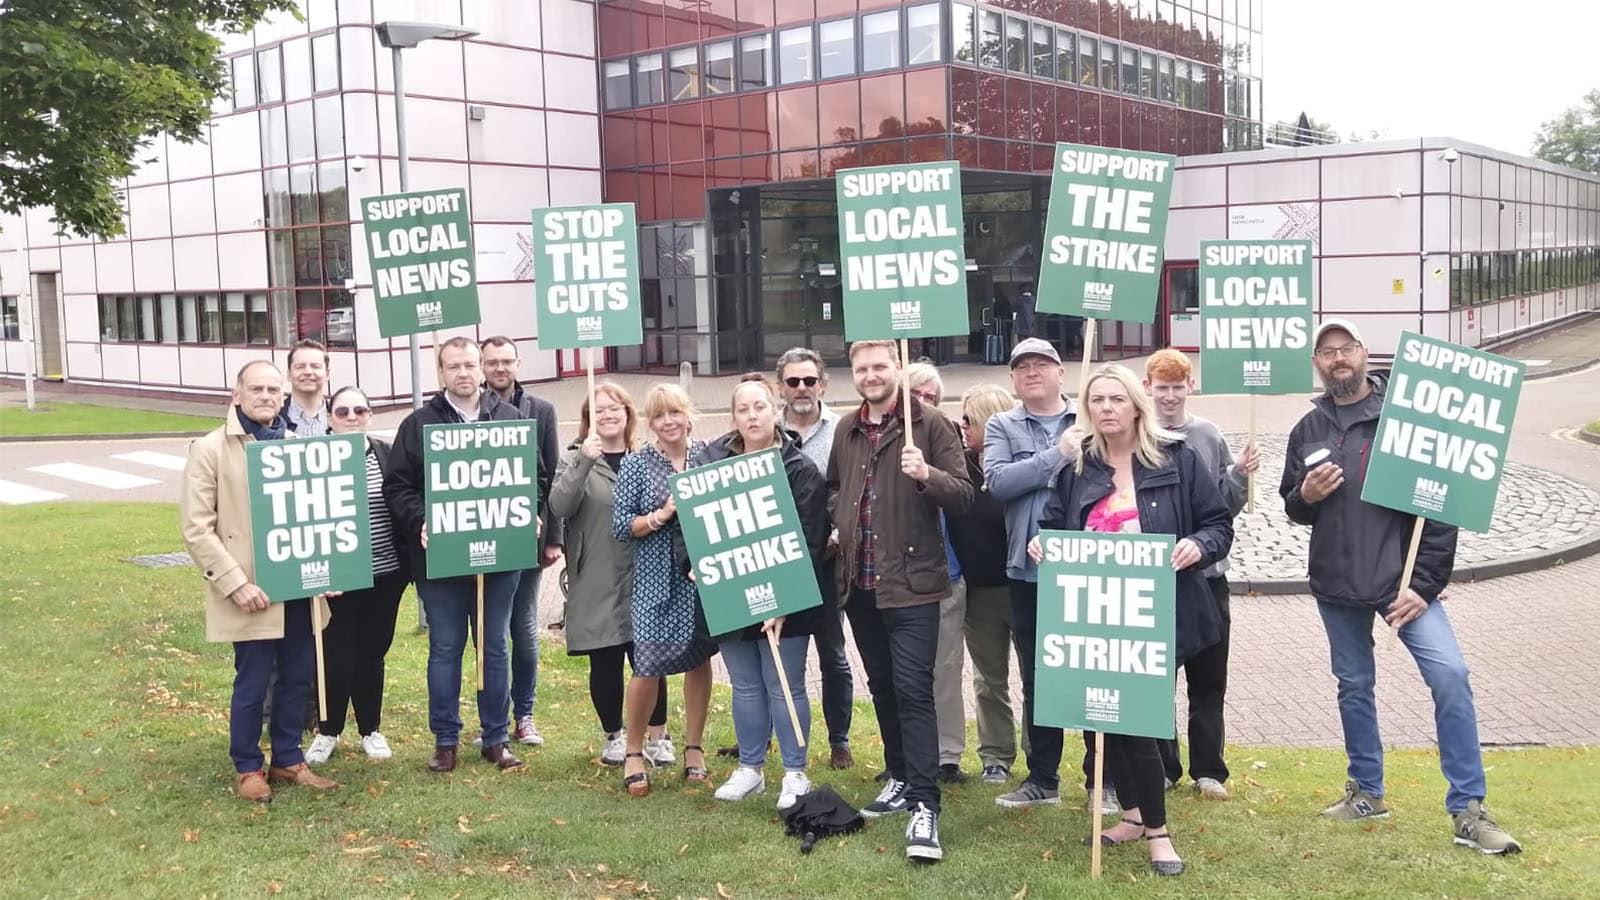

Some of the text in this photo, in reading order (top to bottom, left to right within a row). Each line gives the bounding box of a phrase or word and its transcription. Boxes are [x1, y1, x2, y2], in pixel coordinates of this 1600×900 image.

[842, 167, 954, 198] SUPPORT
[1060, 149, 1170, 183] SUPPORT
[367, 192, 461, 221] SUPPORT
[844, 203, 958, 244] LOCAL
[1067, 183, 1155, 234] THE
[370, 222, 467, 259] LOCAL
[543, 208, 625, 241] STOP
[544, 239, 628, 283] THE
[847, 248, 960, 291] NEWS
[1049, 234, 1158, 274] STRIKE
[1205, 244, 1307, 266] SUPPORT
[376, 258, 471, 298] NEWS
[1084, 281, 1114, 296] NUJ
[1205, 276, 1308, 307] LOCAL
[415, 301, 442, 314] NUJ
[547, 280, 629, 315] CUTS
[890, 300, 921, 315] NUJ
[576, 315, 603, 329] NUJ
[1205, 316, 1308, 349] NEWS
[1243, 360, 1271, 372] NUJ
[1403, 338, 1519, 388] SUPPORT
[1391, 373, 1506, 434] LOCAL
[430, 425, 531, 451] SUPPORT
[1380, 417, 1499, 481] NEWS
[260, 439, 353, 479] STOP
[431, 457, 531, 492] LOCAL
[676, 453, 776, 500] SUPPORT
[262, 474, 357, 525] THE
[1415, 477, 1449, 496] NUJ
[431, 495, 531, 534] NEWS
[692, 484, 784, 545] THE
[266, 520, 359, 562] CUTS
[469, 540, 496, 554] NUJ
[698, 531, 804, 586] STRIKE
[1045, 536, 1169, 567] SUPPORT
[300, 560, 330, 575] NUJ
[744, 582, 774, 601] NUJ
[1056, 574, 1155, 628] THE
[1042, 633, 1167, 677] STRIKE
[1085, 687, 1120, 705] NUJ
[1353, 799, 1374, 816] N
